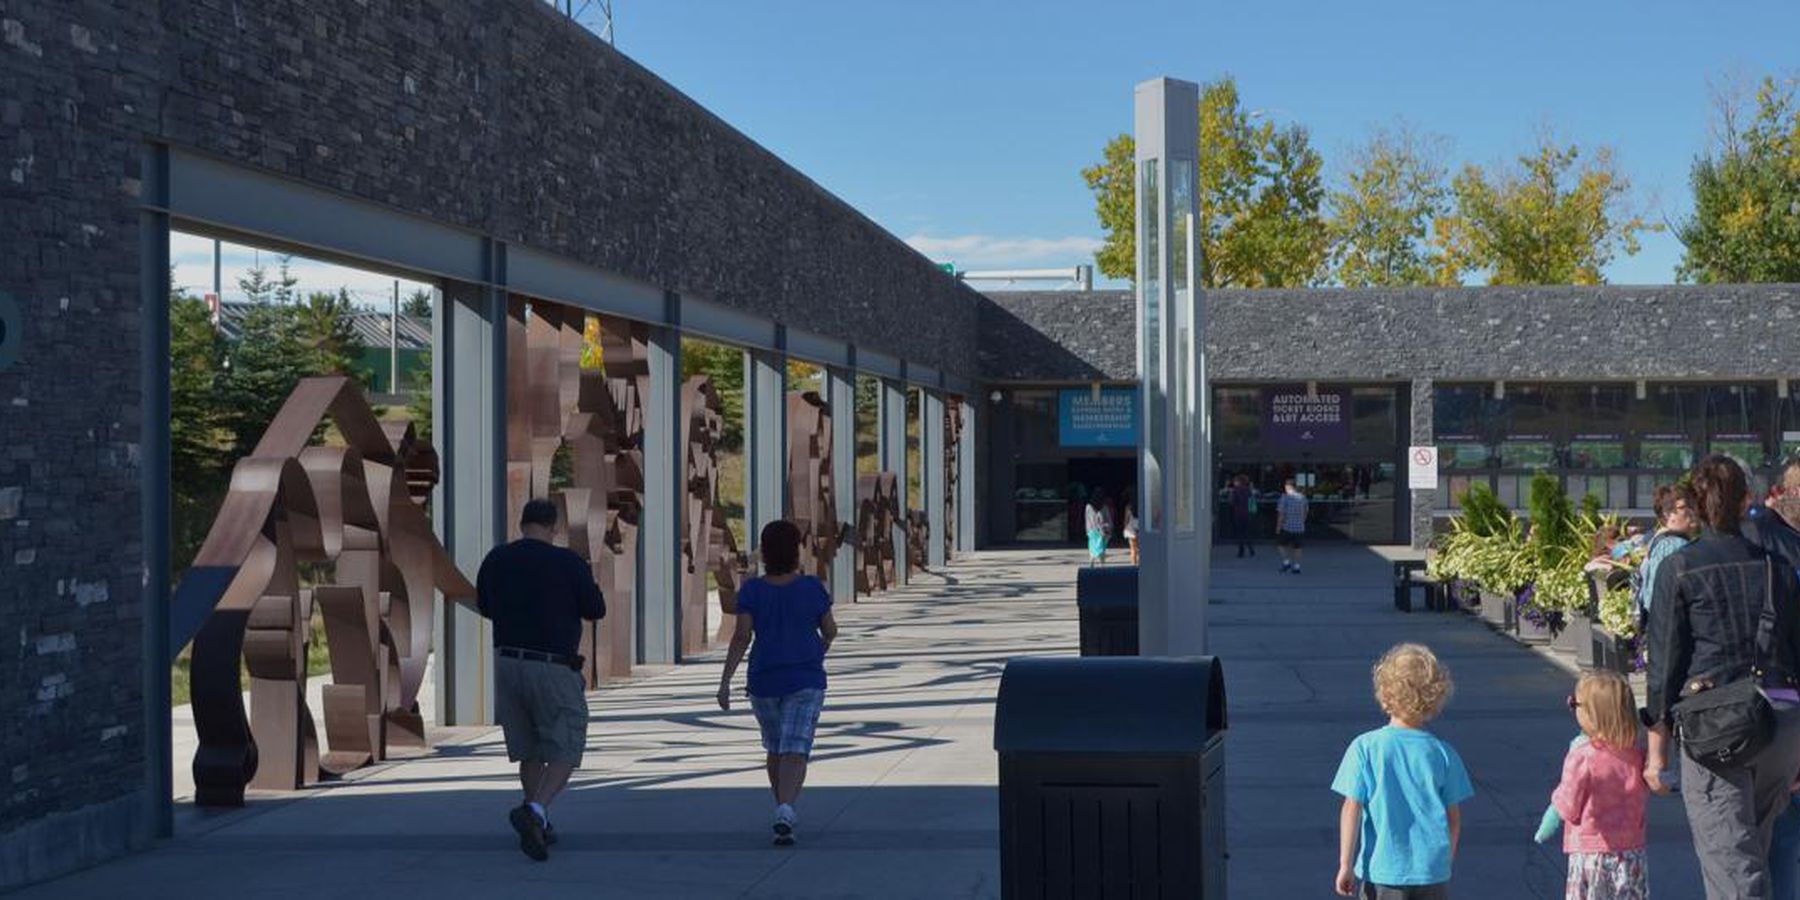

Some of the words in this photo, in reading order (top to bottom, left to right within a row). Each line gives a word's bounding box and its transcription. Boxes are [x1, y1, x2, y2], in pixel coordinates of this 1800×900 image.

[1273, 394, 1340, 404] AUTOMATED
[1273, 404, 1303, 413] TICKET
[1306, 404, 1340, 413] KIOSKS
[1300, 413, 1340, 422] ACCESS
